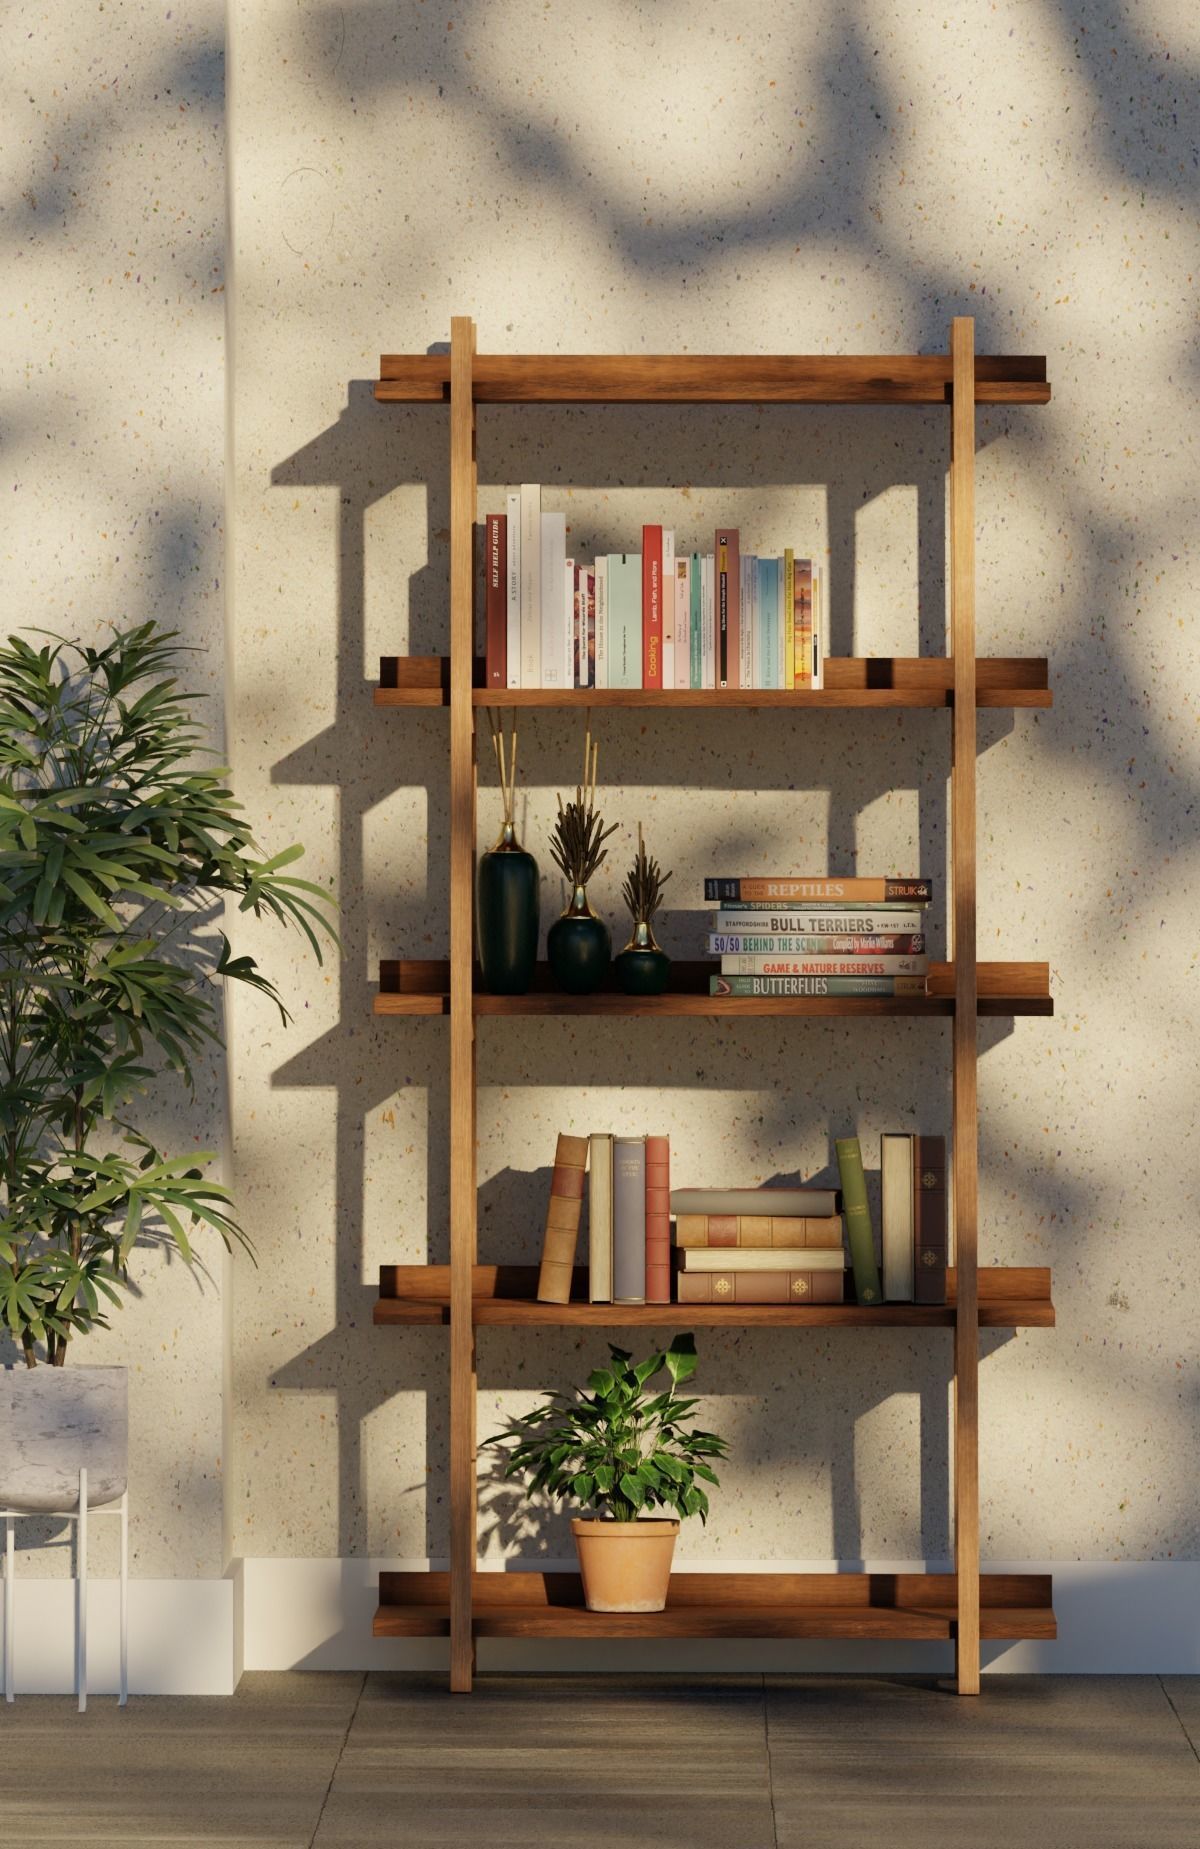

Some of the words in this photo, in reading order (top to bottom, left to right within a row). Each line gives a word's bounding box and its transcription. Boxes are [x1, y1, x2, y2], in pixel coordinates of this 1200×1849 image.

[648, 636, 659, 677] Cooking
[767, 883, 844, 897] REPTILES
[888, 885, 918, 896] STRUIK
[750, 902, 788, 910] SPIDERS
[725, 920, 768, 928] STAFFORDSHIRE
[771, 918, 804, 931] BULL
[809, 918, 874, 932] TERRIERS
[714, 936, 740, 952] 50/50
[742, 937, 774, 951] BEHIND
[778, 937, 793, 951] THE
[763, 963, 791, 974] GAME
[792, 963, 800, 974] &
[802, 963, 838, 974] NATURE
[840, 963, 885, 974] RESERVES
[753, 978, 828, 994] BUTTERFLIES
